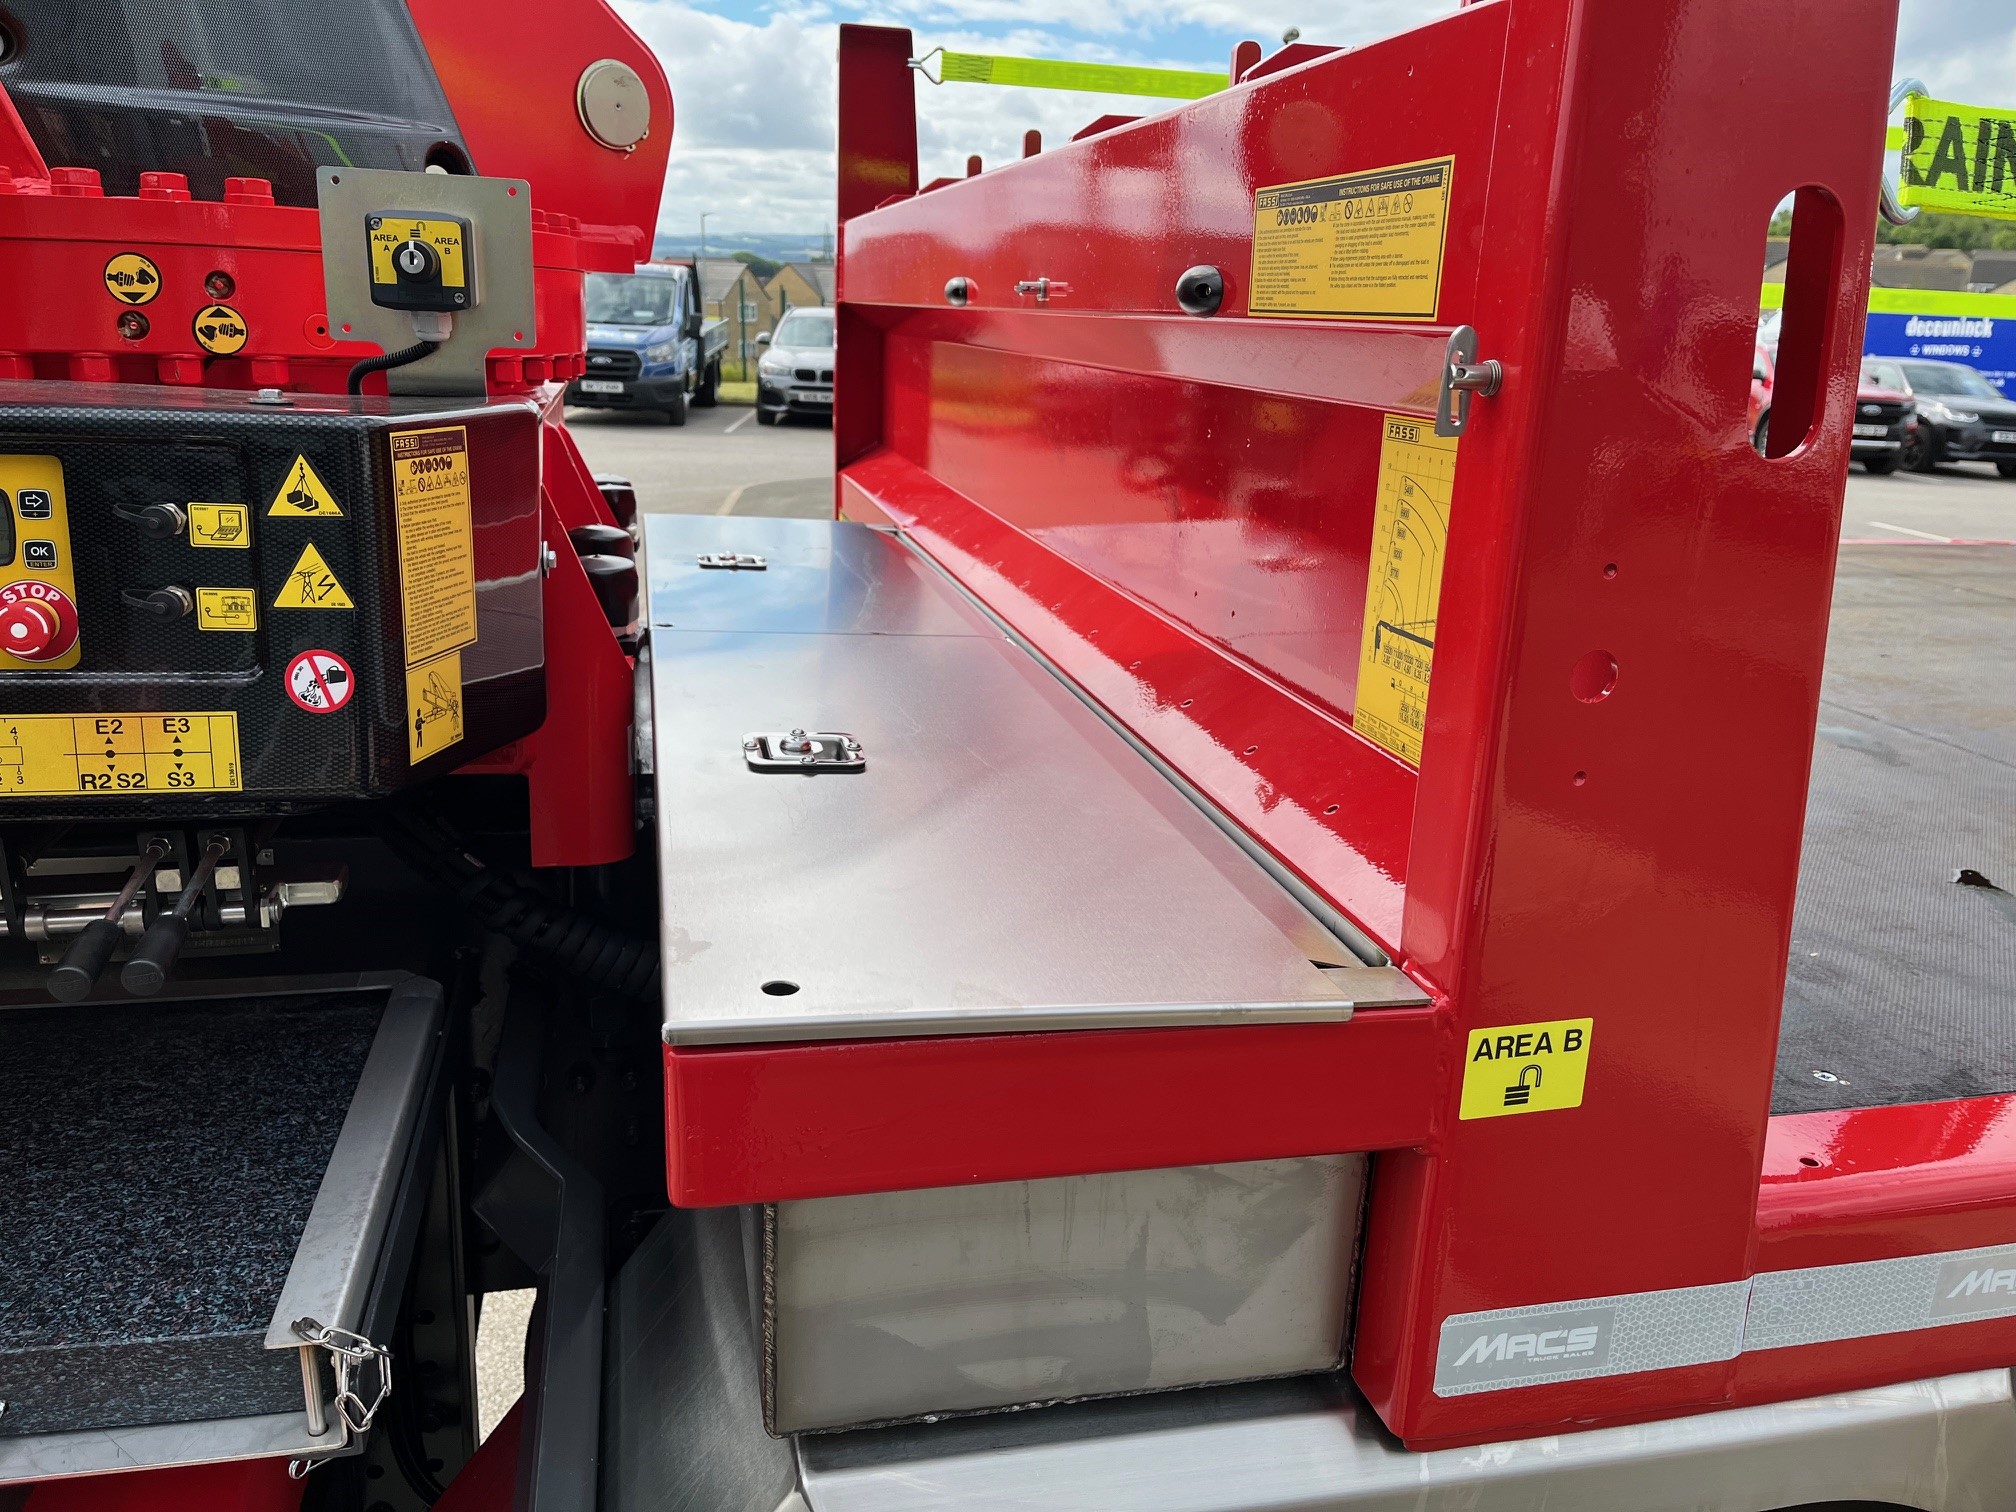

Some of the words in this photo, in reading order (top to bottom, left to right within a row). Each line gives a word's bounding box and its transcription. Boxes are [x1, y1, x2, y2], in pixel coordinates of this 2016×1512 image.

[1338, 184, 1369, 196] INSTRUCTIONS
[1370, 183, 1380, 192] FOR
[1380, 181, 1393, 191] SAFE
[1393, 180, 1402, 189] USE
[1403, 179, 1411, 187] OF
[1411, 177, 1421, 186] THE
[1421, 174, 1440, 185] CRANE
[1260, 196, 1278, 207] FASSI
[373, 234, 399, 243] AREA
[434, 237, 460, 246] AREA
[383, 244, 391, 252] A
[1922, 344, 1970, 357] WINDOWS
[1389, 425, 1418, 440] FASSI
[395, 438, 417, 449] FASSI
[30, 546, 49, 556] OK
[2, 584, 60, 604] STOP
[10, 726, 17, 735] 4
[95, 719, 124, 735] E2
[162, 718, 191, 734] E3
[16, 775, 24, 785] 3
[81, 773, 113, 790] R2
[116, 772, 146, 789] S2
[167, 772, 196, 787] S3
[1472, 1032, 1553, 1062] AREA
[1563, 1029, 1583, 1052] B
[1946, 1268, 2016, 1299] MA
[1528, 1354, 1559, 1363] TRUCK
[1563, 1350, 1595, 1359] SALES
